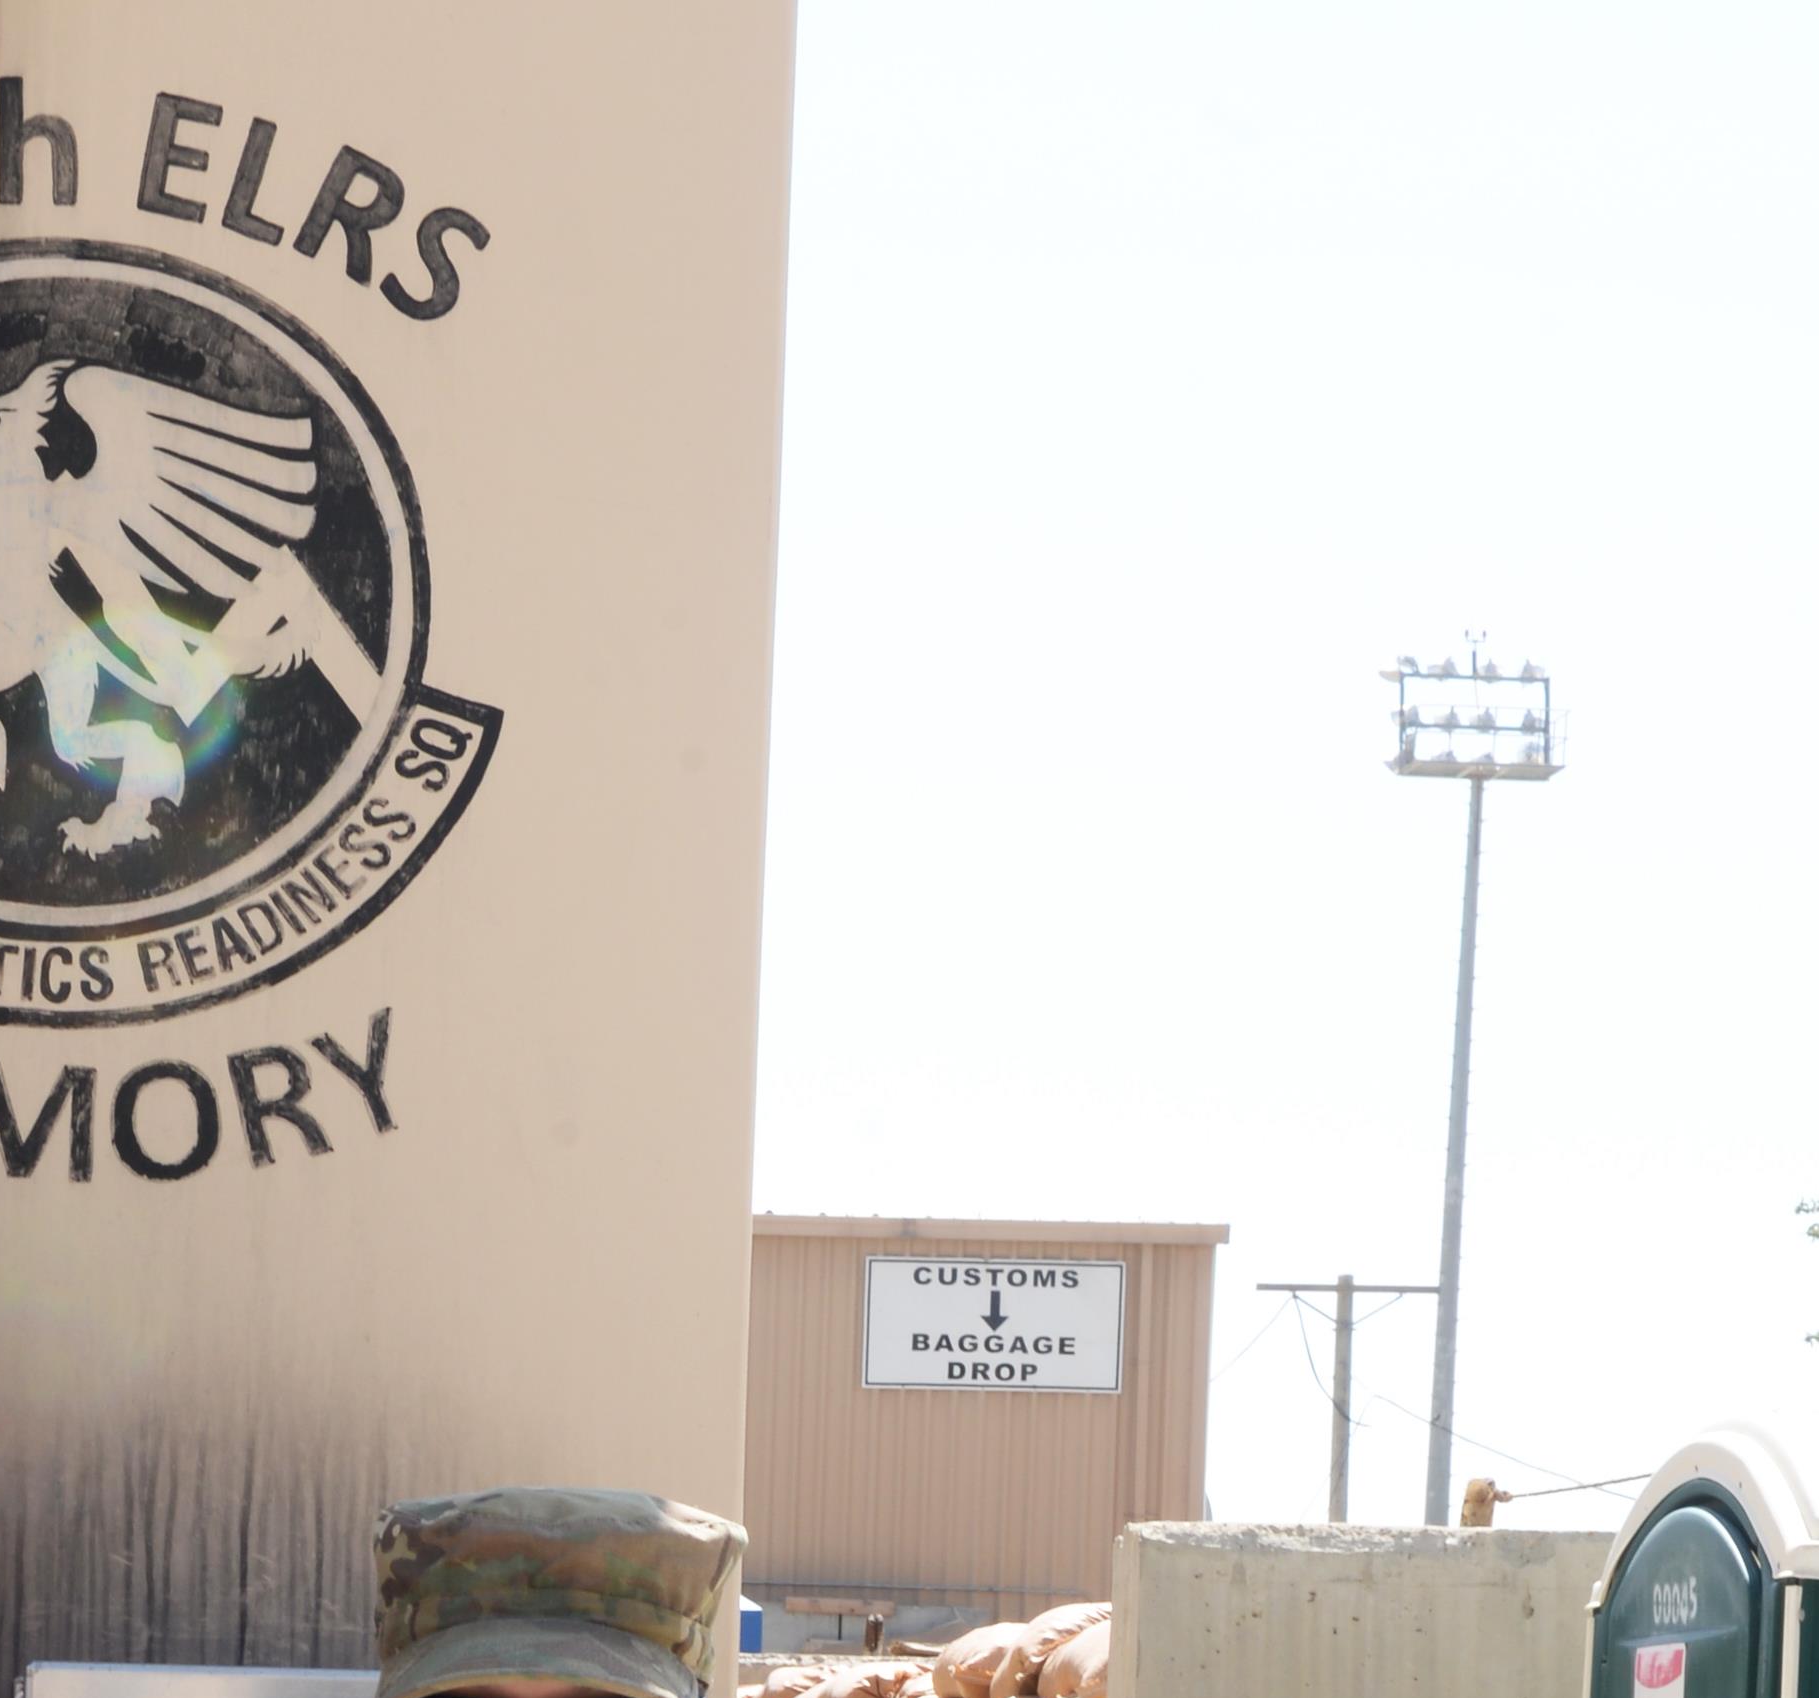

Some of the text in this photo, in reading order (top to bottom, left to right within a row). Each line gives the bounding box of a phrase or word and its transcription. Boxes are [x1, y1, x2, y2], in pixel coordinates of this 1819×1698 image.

[138, 91, 490, 322] ELRS
[139, 795, 418, 996] READINESS
[393, 714, 475, 793] SQ
[913, 1266, 1080, 1289] CUSTOMS
[911, 1333, 1077, 1356] BAGGAGE
[947, 1362, 1039, 1382] DROP
